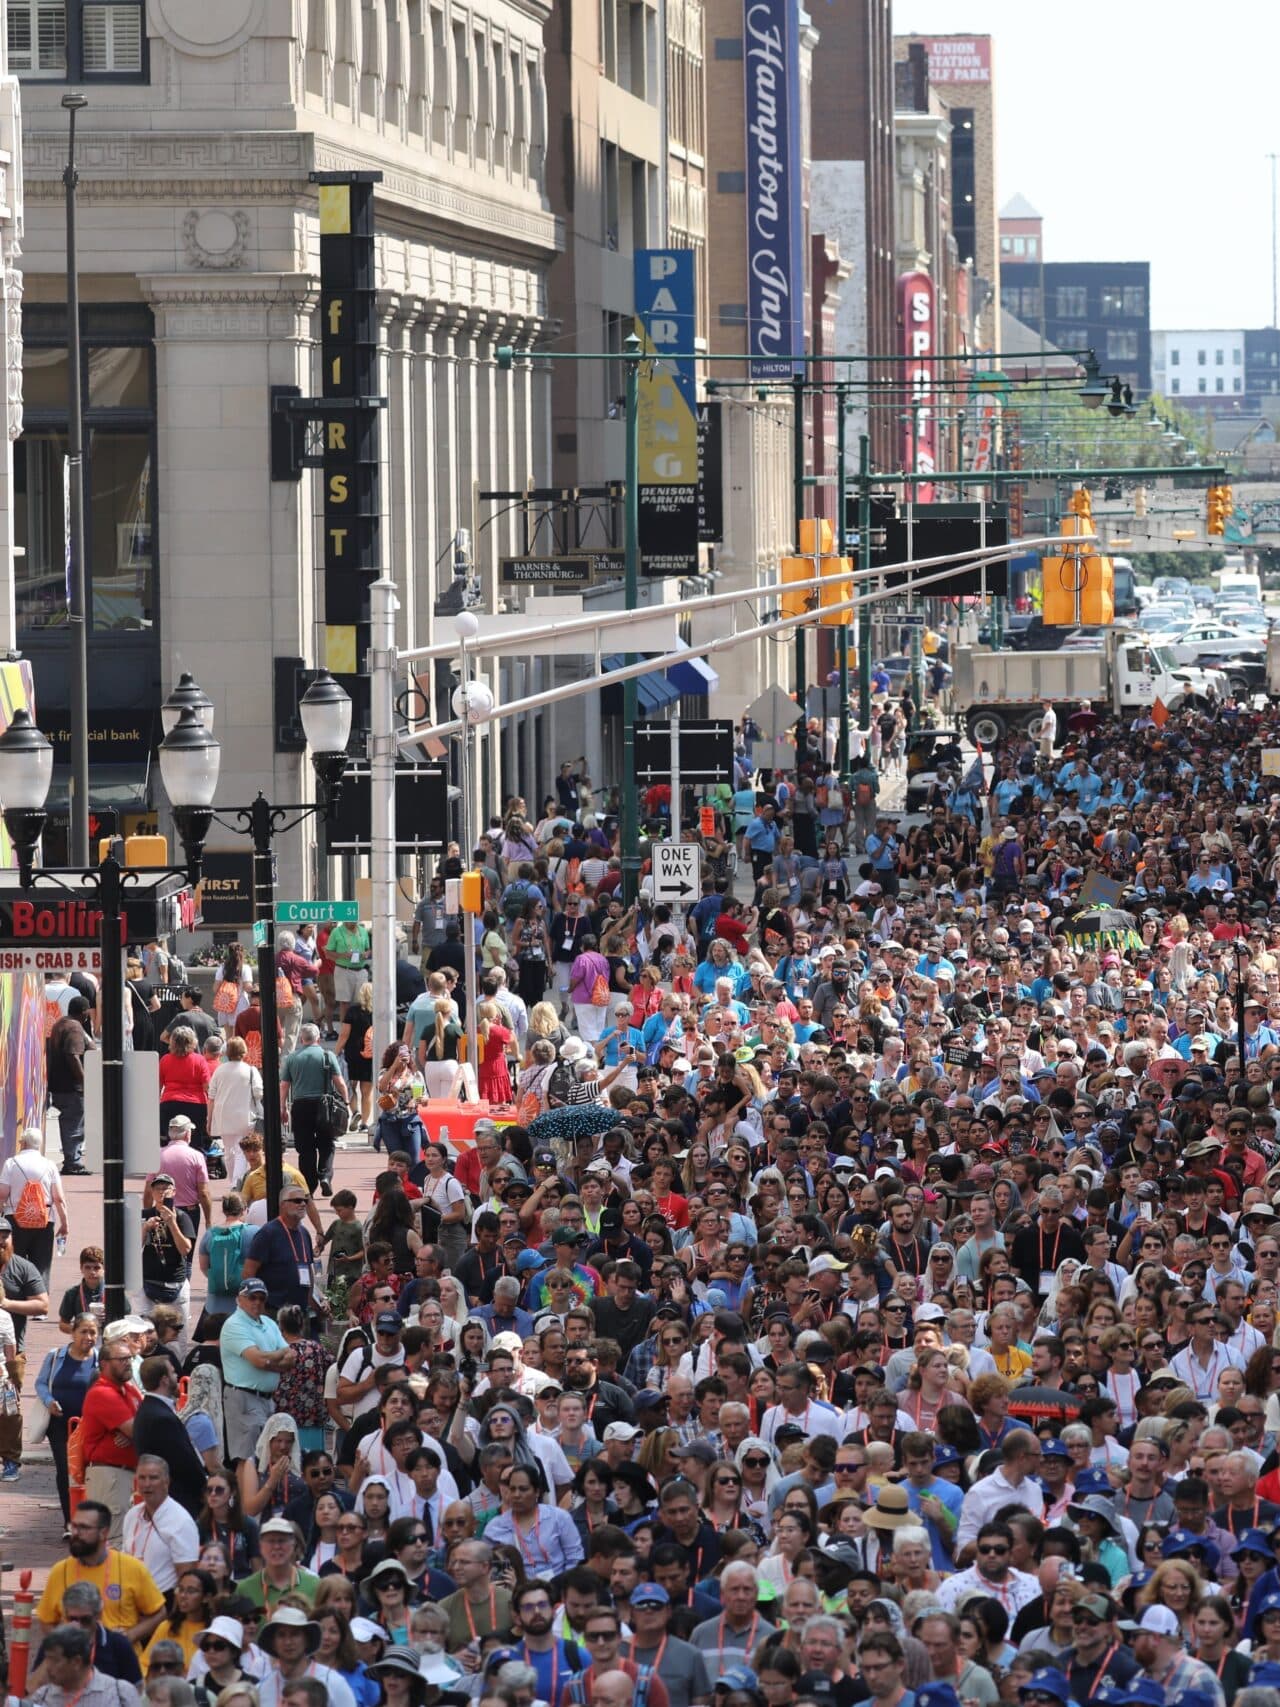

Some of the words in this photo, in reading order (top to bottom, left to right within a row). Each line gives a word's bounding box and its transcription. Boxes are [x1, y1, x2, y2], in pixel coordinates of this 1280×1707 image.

[933, 42, 976, 54] UNION
[954, 68, 989, 80] PARK
[747, 3, 783, 240] Hampton
[752, 250, 788, 357] Inn
[763, 364, 790, 372] HILTON
[641, 487, 695, 495] DENISON
[641, 496, 695, 504] PARKING
[656, 504, 680, 512] INC.
[514, 562, 551, 571] BARNES
[513, 570, 575, 579] THORNBURG
[111, 729, 140, 741] bank
[661, 848, 692, 861] ONE
[662, 863, 693, 877] WAY
[289, 904, 334, 920] Court
[36, 952, 73, 968] CRAB
